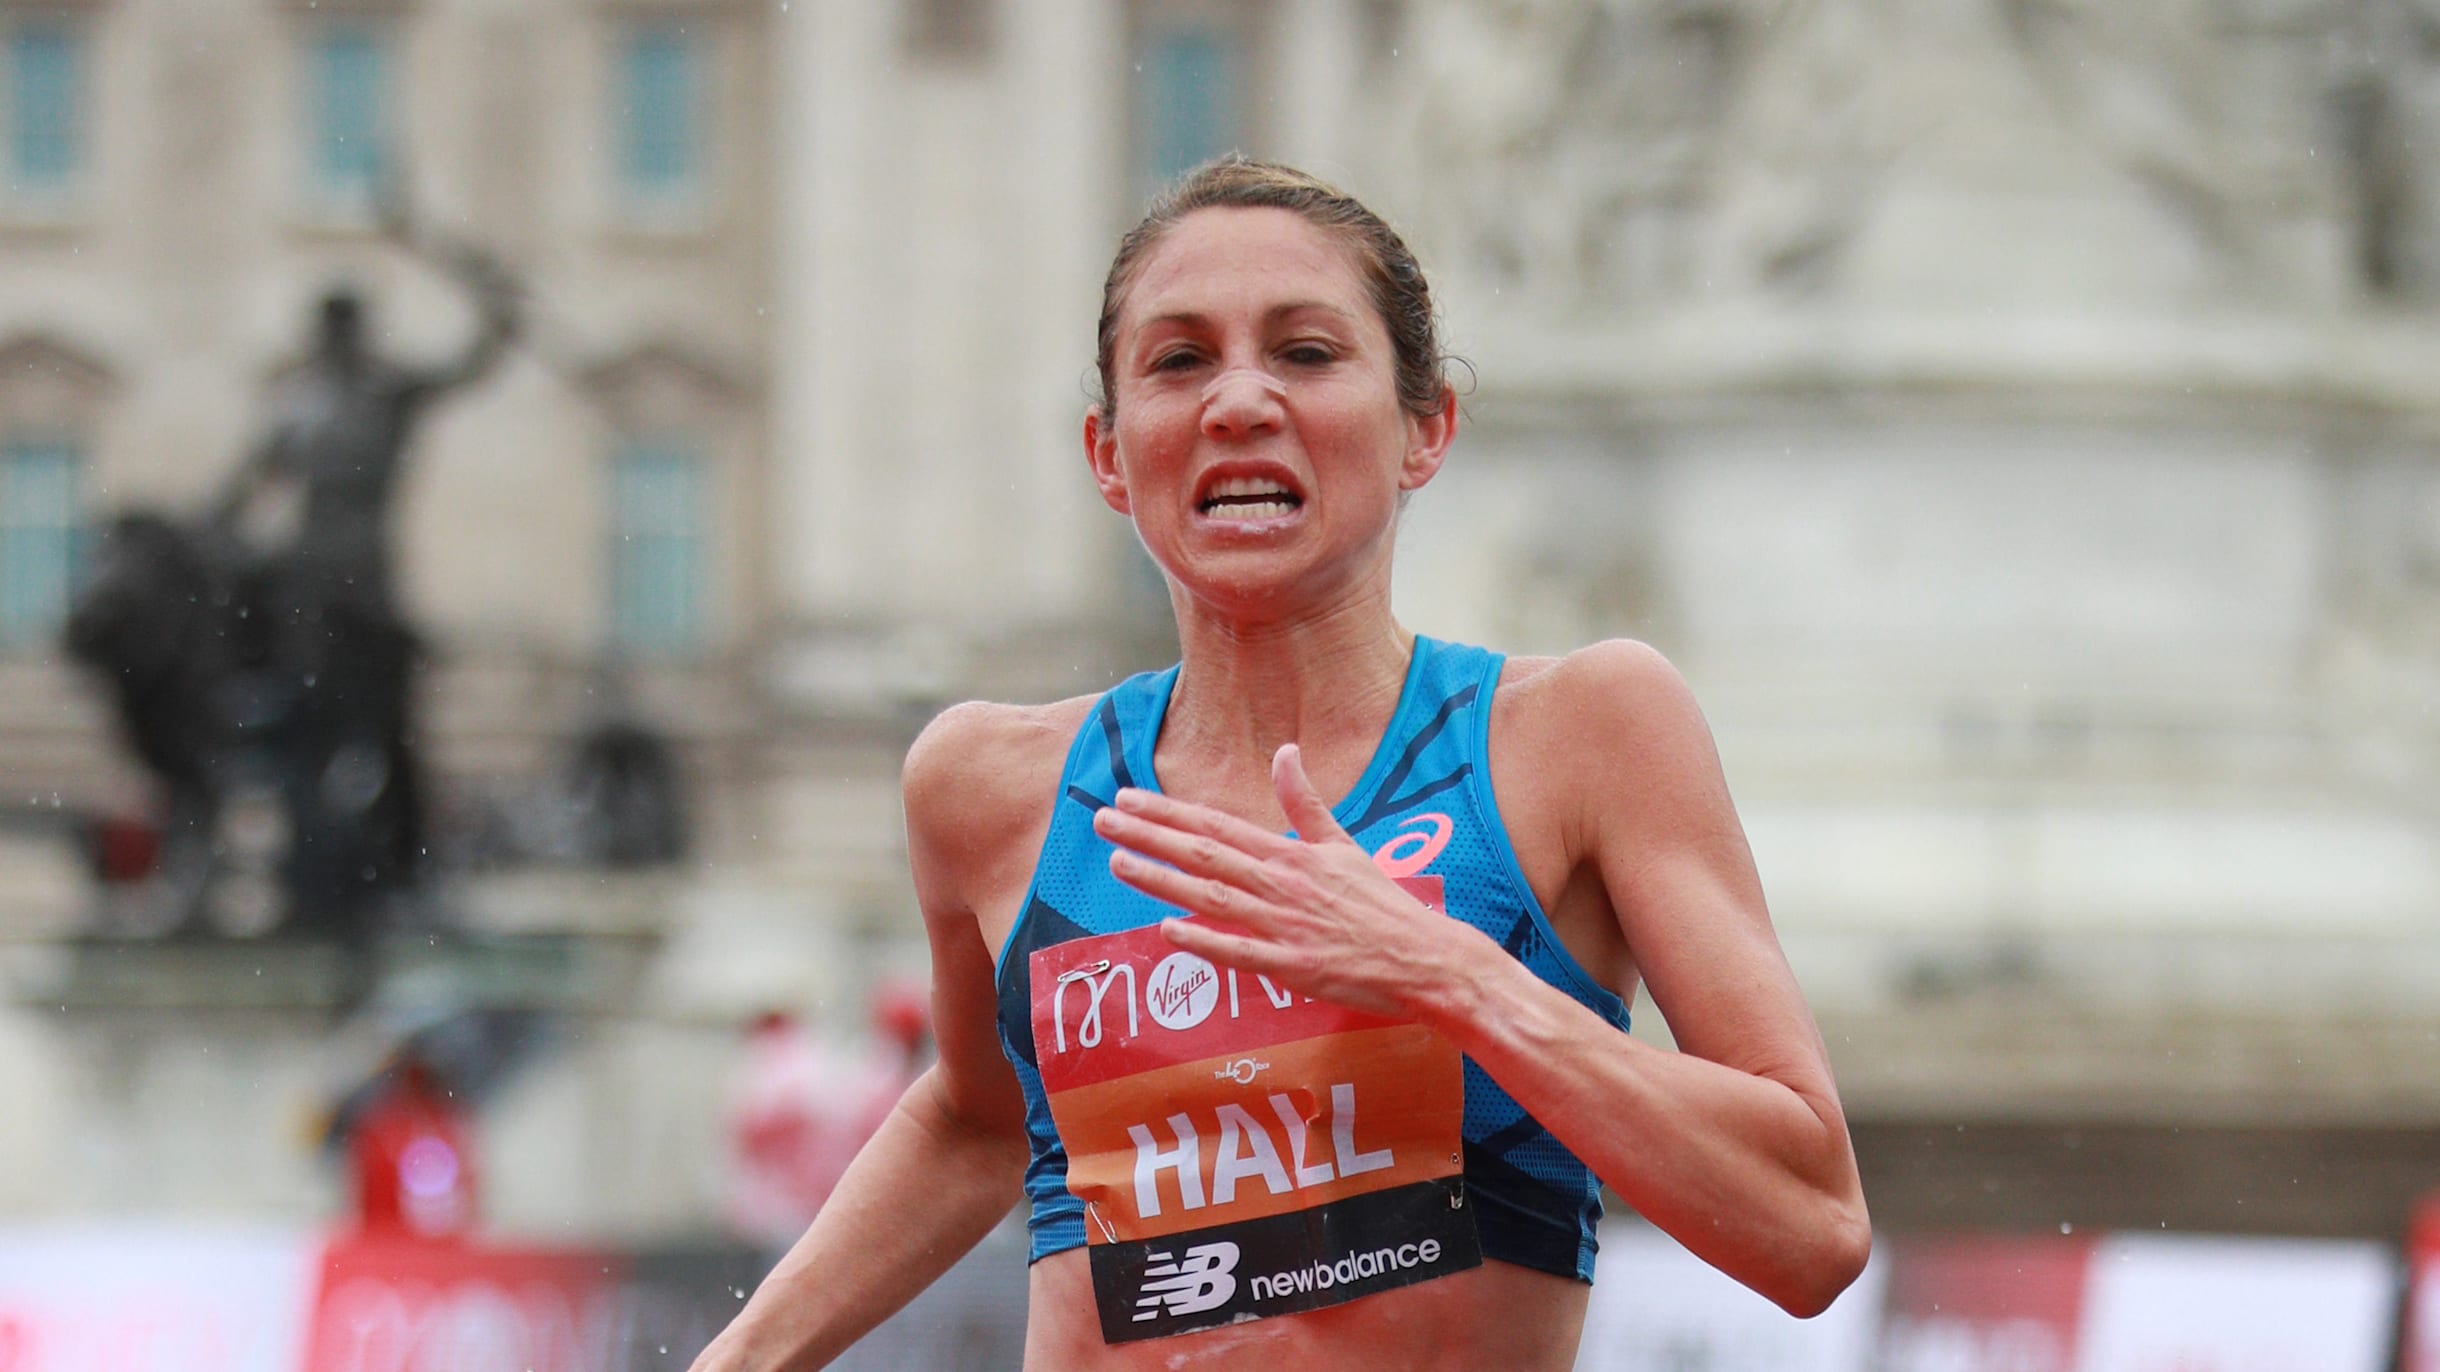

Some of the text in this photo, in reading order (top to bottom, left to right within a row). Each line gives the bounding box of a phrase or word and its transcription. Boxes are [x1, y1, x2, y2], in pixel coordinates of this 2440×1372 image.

[1153, 964, 1211, 1018] Virgin
[1126, 1083, 1395, 1219] HALL
[1131, 1241, 1241, 1323] NB
